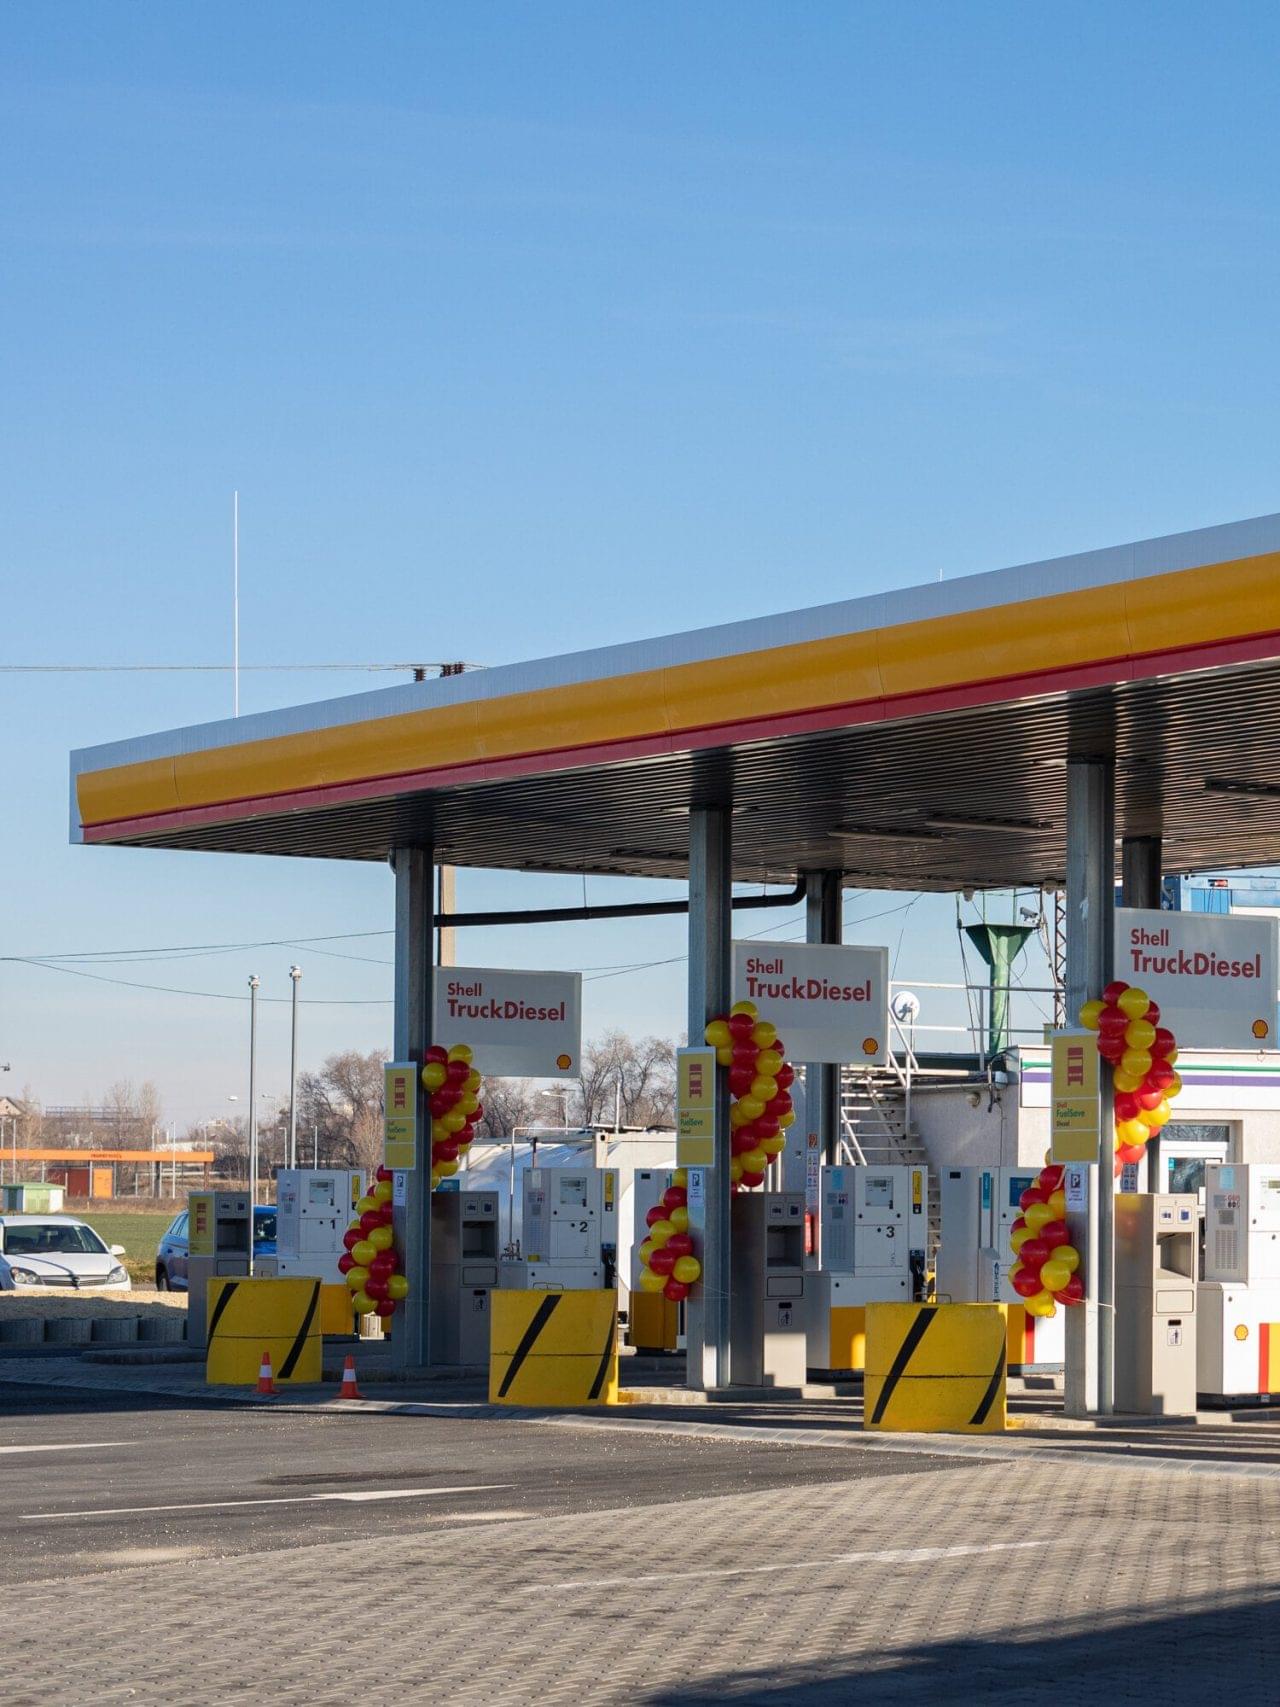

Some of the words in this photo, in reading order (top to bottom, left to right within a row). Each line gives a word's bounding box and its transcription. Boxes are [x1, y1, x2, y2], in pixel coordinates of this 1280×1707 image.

[1131, 928, 1169, 946] Shell
[746, 958, 783, 974] Shell
[1131, 949, 1261, 978] TruckDiesel
[447, 982, 482, 996] Shell
[746, 976, 871, 1001] TruckDiesel
[447, 998, 565, 1021] TruckDiesel
[1056, 1108, 1086, 1117] FuelSave
[330, 1219, 336, 1229] 1
[579, 1221, 588, 1233] 2
[885, 1226, 895, 1238] 3
